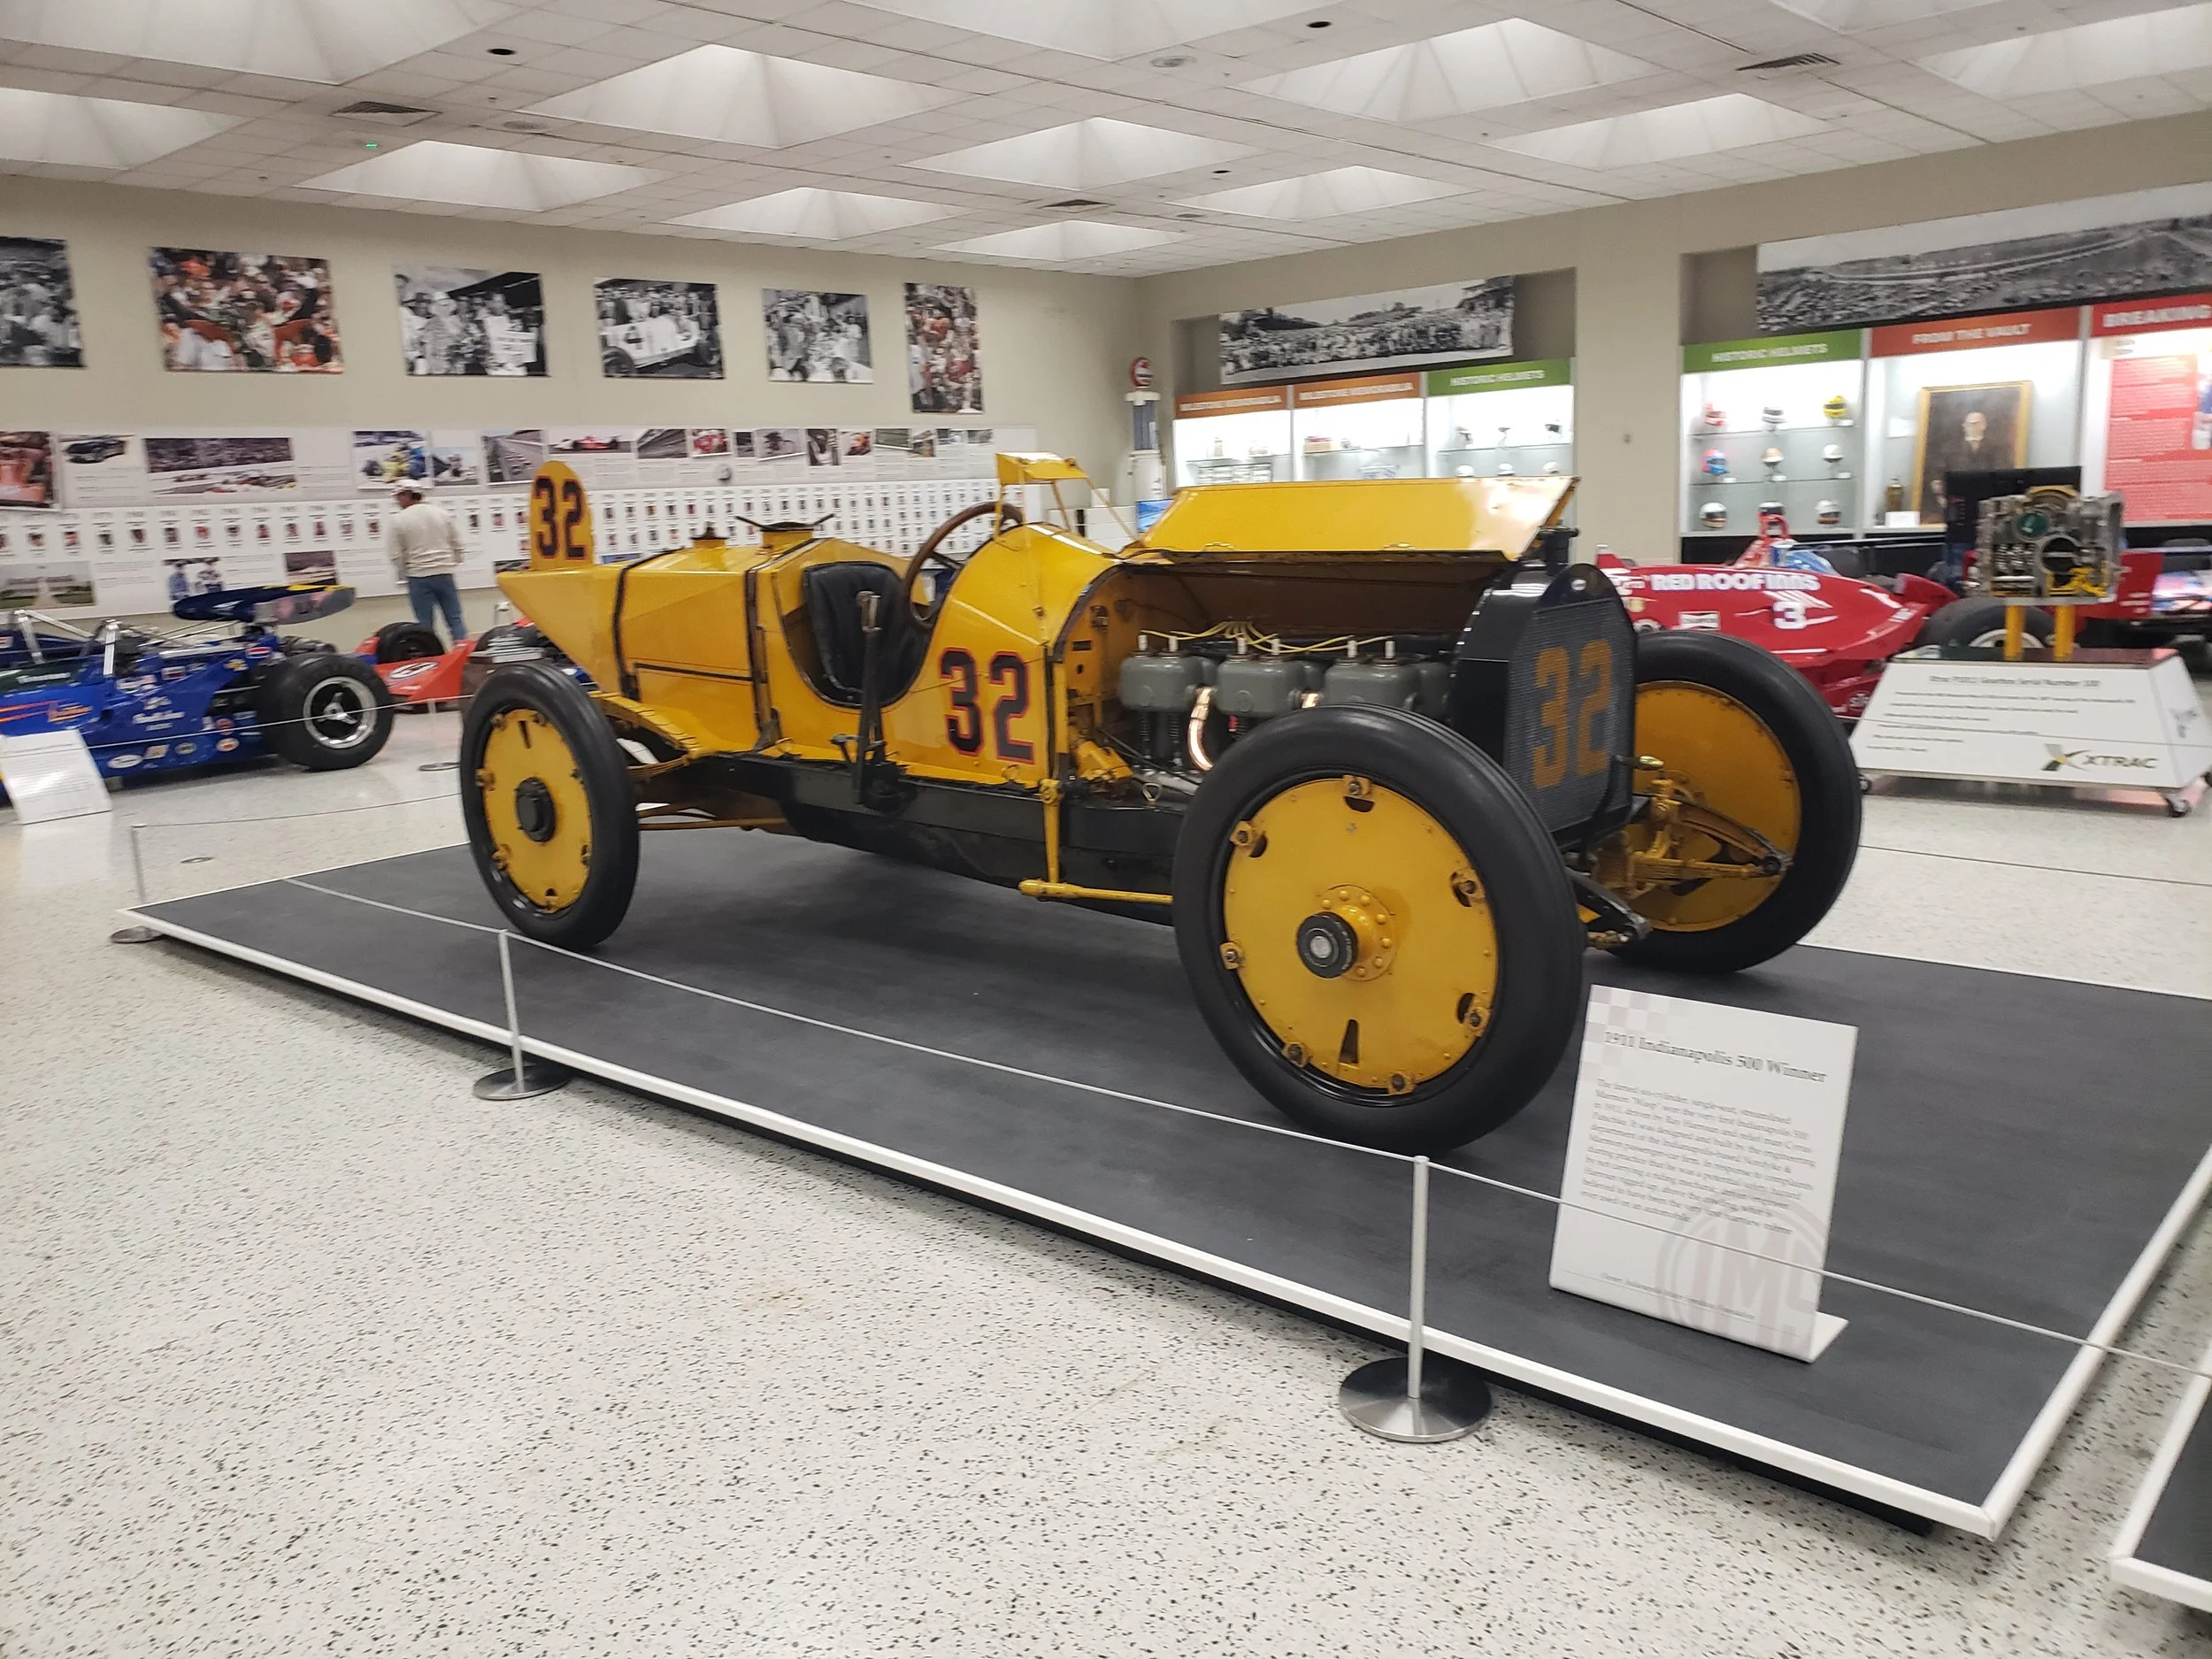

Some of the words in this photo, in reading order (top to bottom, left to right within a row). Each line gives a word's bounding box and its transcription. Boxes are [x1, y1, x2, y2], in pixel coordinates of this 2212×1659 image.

[534, 475, 587, 560] 32
[1650, 573, 1695, 591] RED
[1696, 572, 1765, 591] ROOF
[1772, 601, 1808, 629] 3
[940, 646, 1035, 765] 32
[1532, 638, 1613, 790] 32
[2082, 754, 2159, 769] XTRAC
[1605, 1031, 1636, 1048] 1911
[1639, 1036, 1732, 1066] Indianapolis
[1736, 1054, 1763, 1071] 500
[1767, 1059, 1828, 1083] Winner
